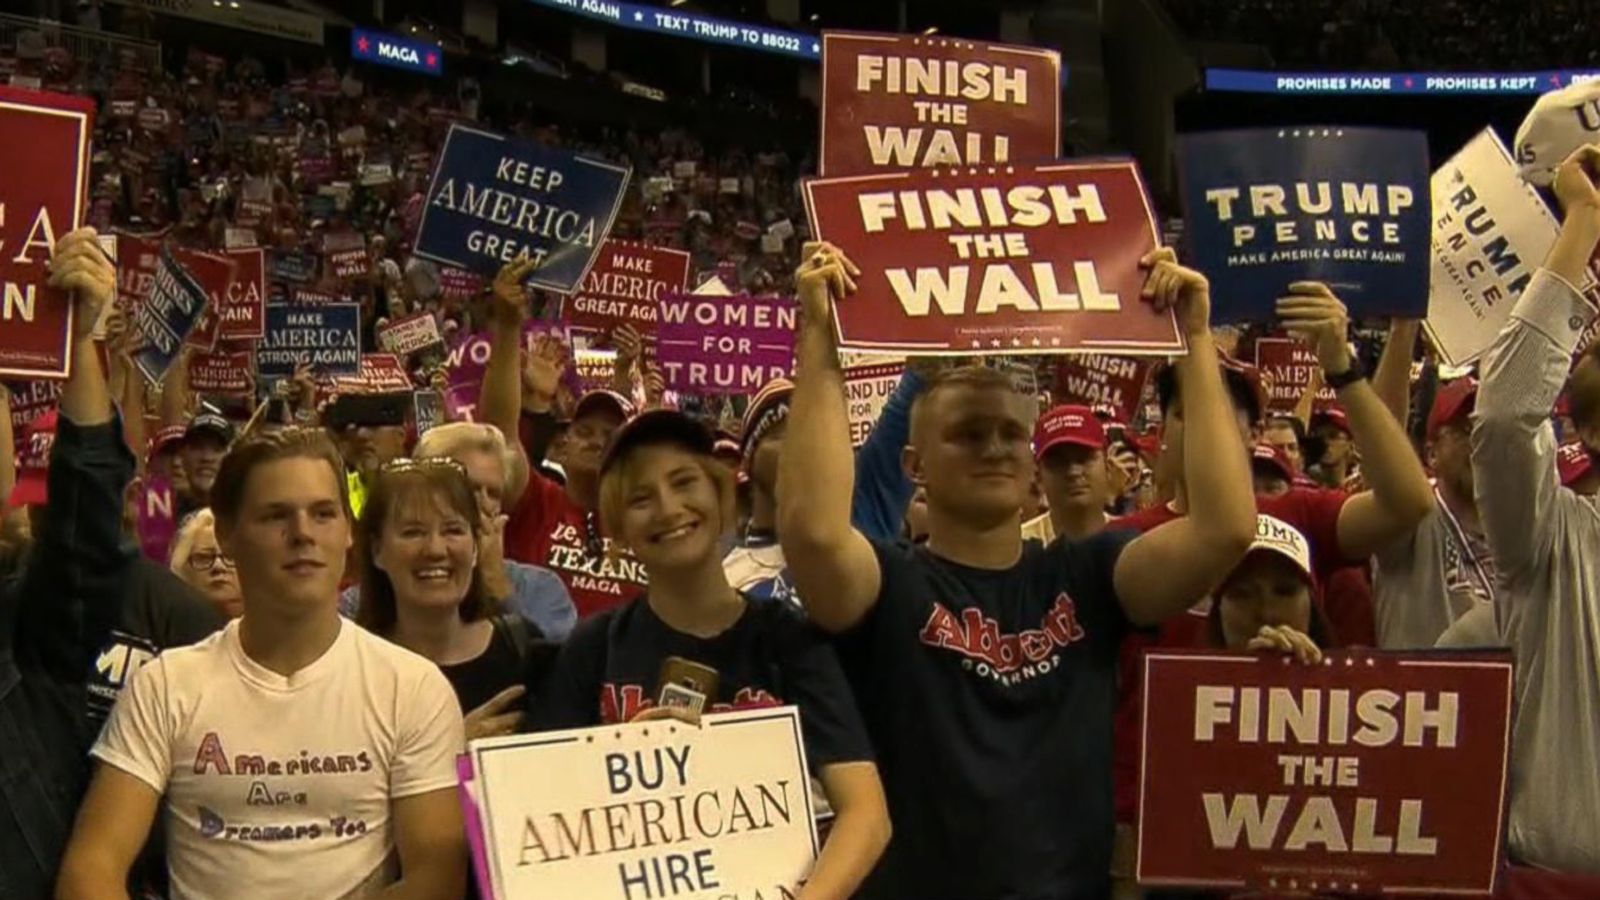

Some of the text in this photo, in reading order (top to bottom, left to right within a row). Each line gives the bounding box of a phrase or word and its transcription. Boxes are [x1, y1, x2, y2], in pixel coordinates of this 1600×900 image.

[581, 1, 621, 19] AGAIN
[655, 13, 691, 30] TEXT
[693, 20, 739, 40] TRUMP
[741, 29, 759, 43] TO
[762, 33, 800, 51] 88022
[378, 43, 419, 64] MAGA
[856, 54, 1028, 104] FINISH
[1277, 77, 1392, 90] PROMISES MADE
[1426, 76, 1537, 90] PROMISES KEPT
[913, 101, 968, 125] THE
[495, 156, 563, 193] KEEP
[432, 178, 596, 248] AMERICA
[858, 183, 1107, 233] FINISH
[1205, 181, 1414, 221] TRUMP
[466, 230, 547, 266] GREAT
[949, 233, 1029, 258] THE
[1233, 220, 1400, 247] PENCE
[336, 264, 366, 277] WALL
[612, 253, 654, 273] MAKE
[1227, 253, 1267, 267] MAKE
[1270, 250, 1330, 263] AMERICA
[1333, 248, 1369, 261] GREAT
[1437, 213, 1503, 306] ENCE
[579, 271, 678, 303] MERIC
[885, 260, 1121, 316] WALL
[220, 306, 252, 321] AIN
[287, 312, 324, 326] MAKE
[574, 297, 657, 322] GREAT AGA
[660, 301, 796, 330] WOMEN
[257, 328, 356, 349] AMERICA
[703, 336, 752, 354] FOR
[258, 349, 357, 365] STRONG AGAIN
[591, 366, 615, 377] AGA
[663, 361, 785, 389] TRUMP
[1067, 374, 1124, 407] WALL
[850, 402, 871, 416] FOR
[1256, 522, 1301, 553] UMP
[549, 544, 649, 585] TEXANS
[571, 575, 622, 596] MAGA
[1194, 685, 1460, 749] FINISH
[193, 731, 373, 776] Americans
[605, 744, 691, 794] BUY
[1277, 754, 1359, 788] THE
[246, 780, 308, 807] Are
[197, 805, 367, 842] Dreamers Too
[516, 779, 793, 867] AMERICAN
[1202, 793, 1438, 856] WALL
[618, 848, 720, 900] HIRE
